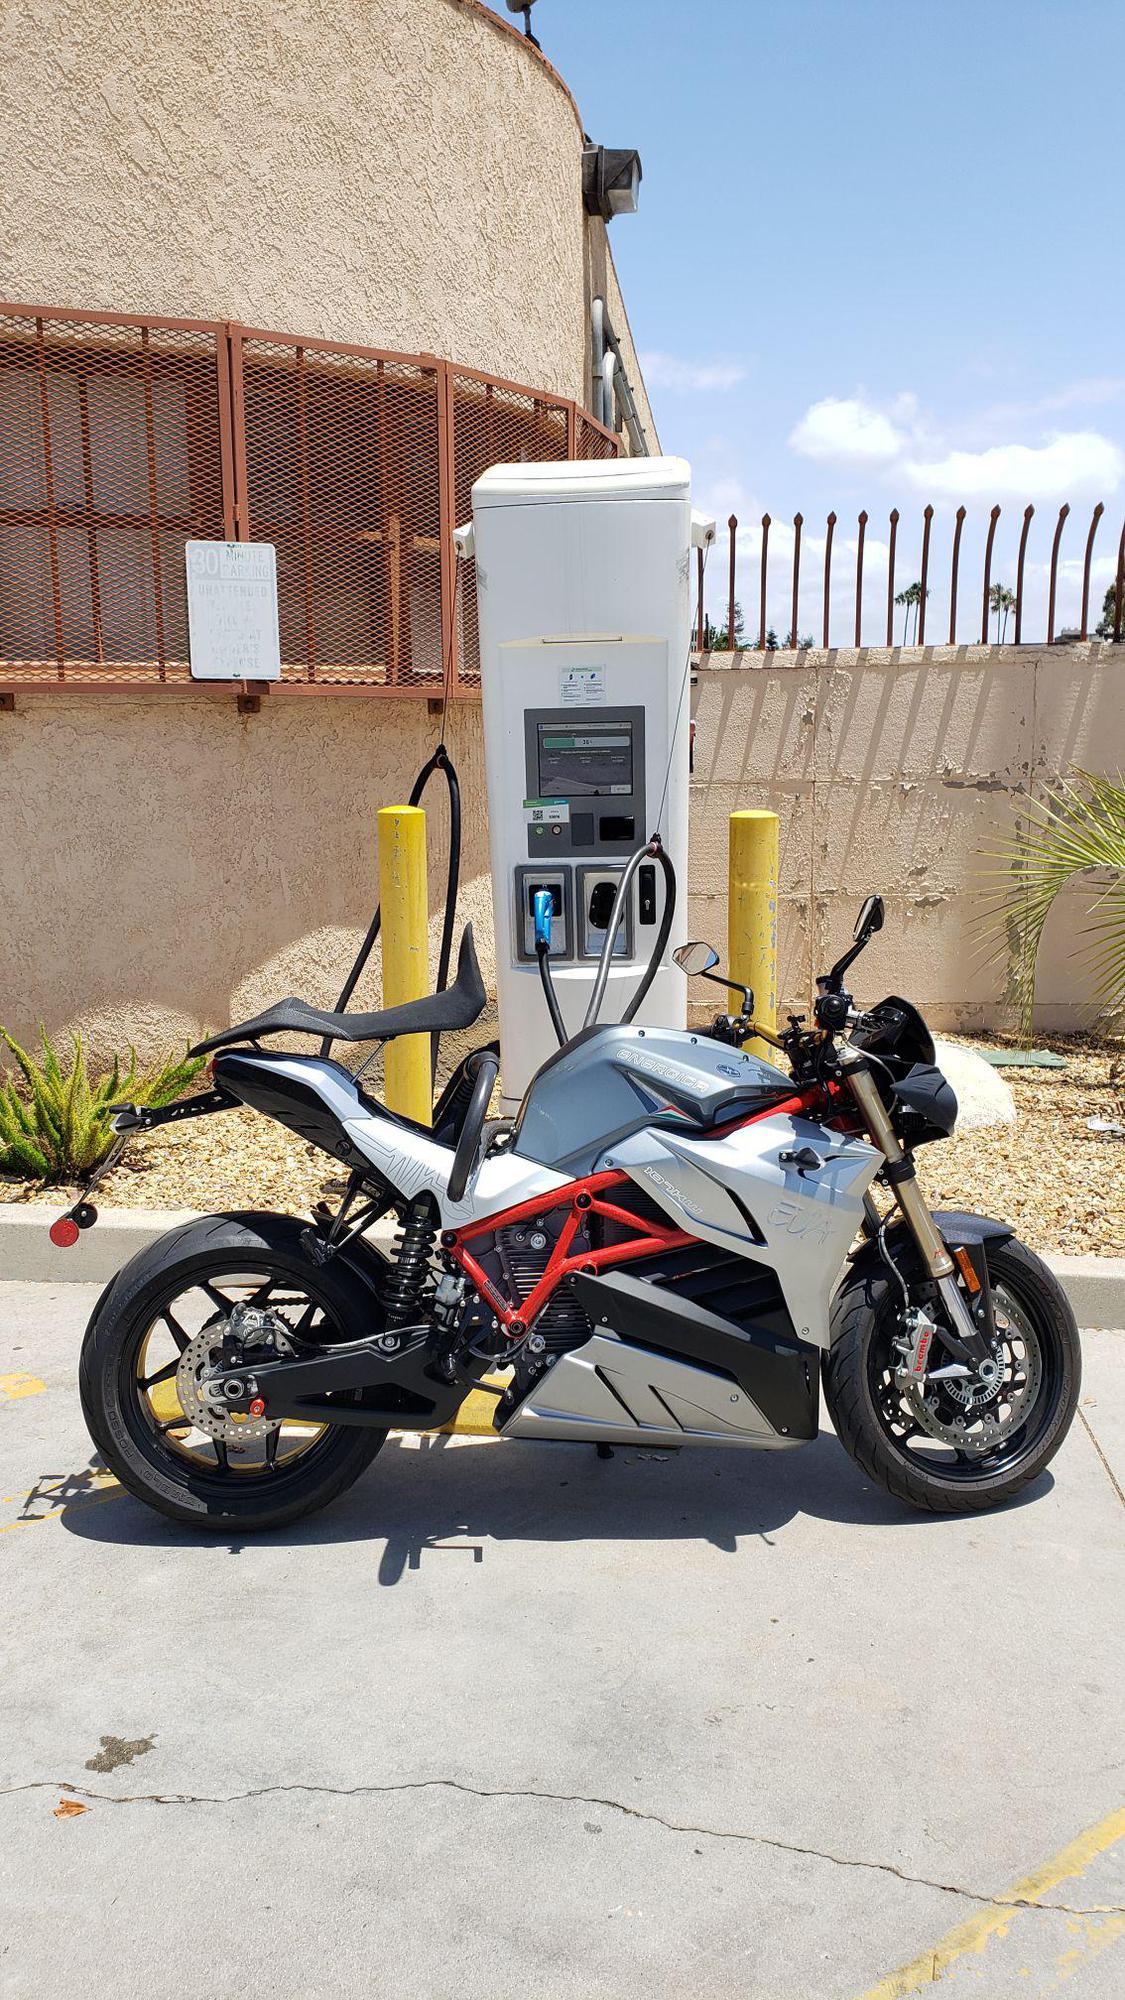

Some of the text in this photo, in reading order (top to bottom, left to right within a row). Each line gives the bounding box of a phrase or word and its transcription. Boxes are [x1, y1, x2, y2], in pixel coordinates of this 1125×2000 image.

[192, 548, 218, 575] 30
[225, 548, 264, 562] MINUTE
[616, 1049, 710, 1094] ENERGICA
[913, 1330, 930, 1373] brembo
